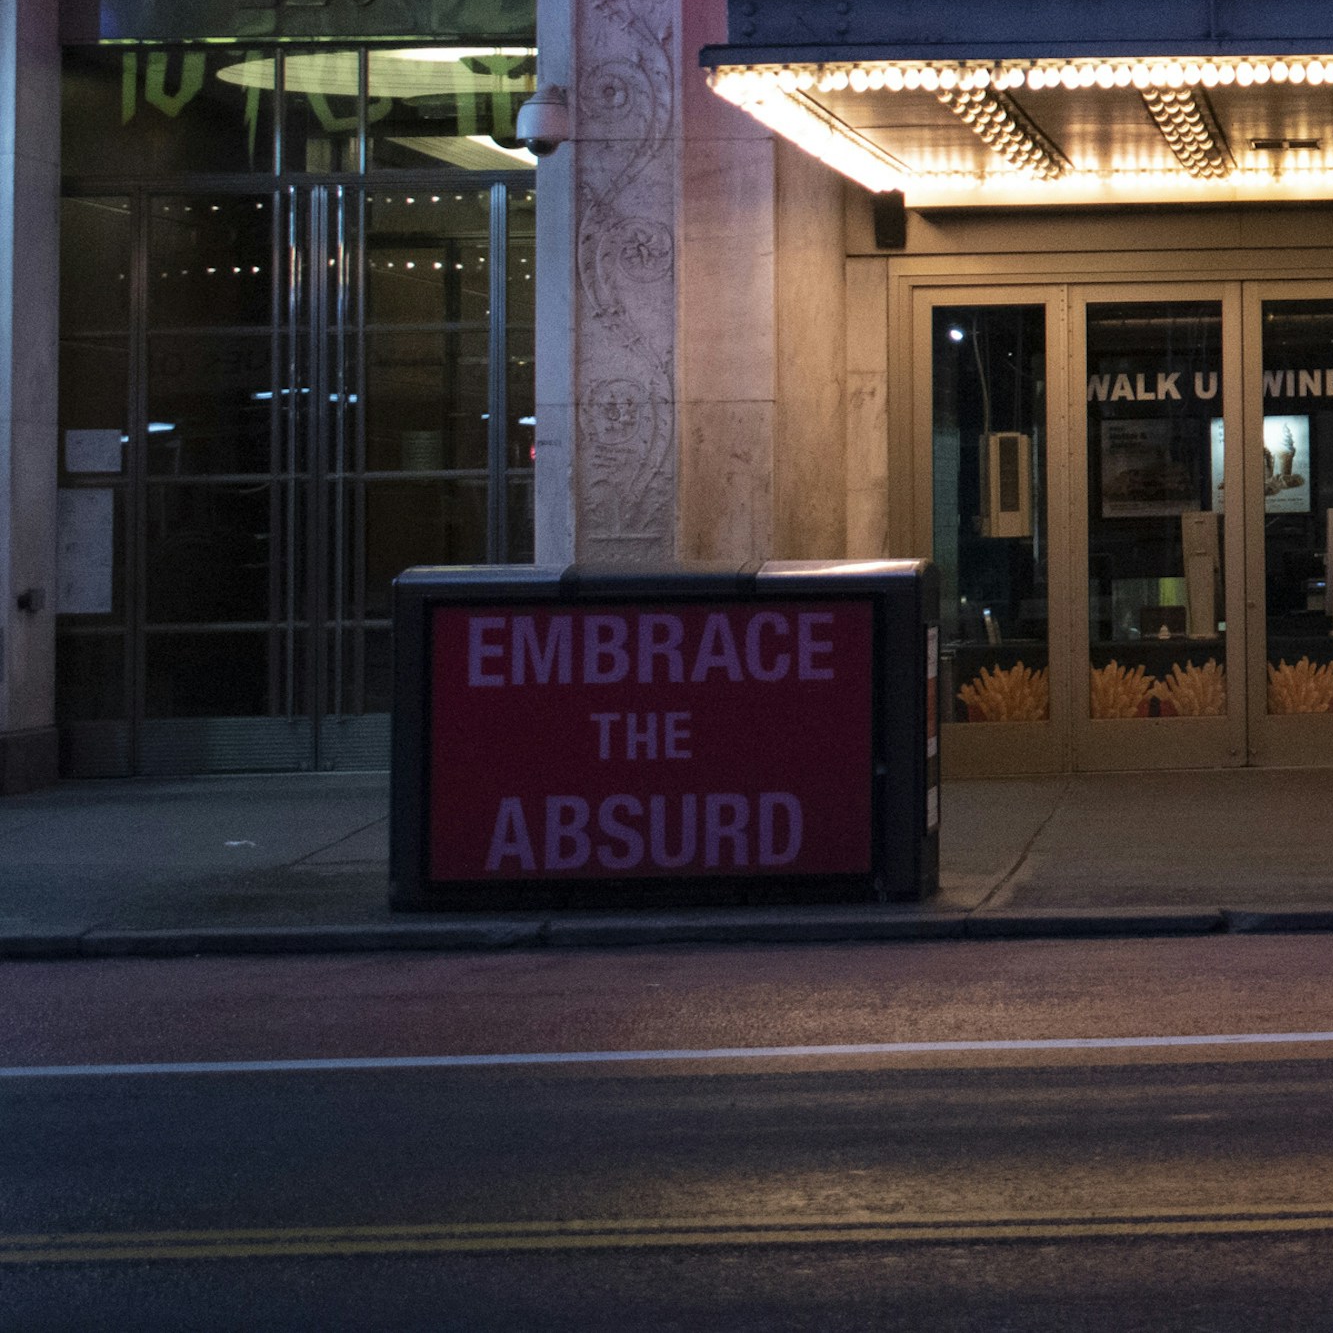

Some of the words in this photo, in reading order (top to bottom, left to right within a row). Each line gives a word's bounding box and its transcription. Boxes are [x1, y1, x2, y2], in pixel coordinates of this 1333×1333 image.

[1088, 371, 1182, 401] WALK
[468, 612, 836, 688] EMBRACE
[590, 712, 694, 762] THE
[485, 792, 806, 873] ABSURD
